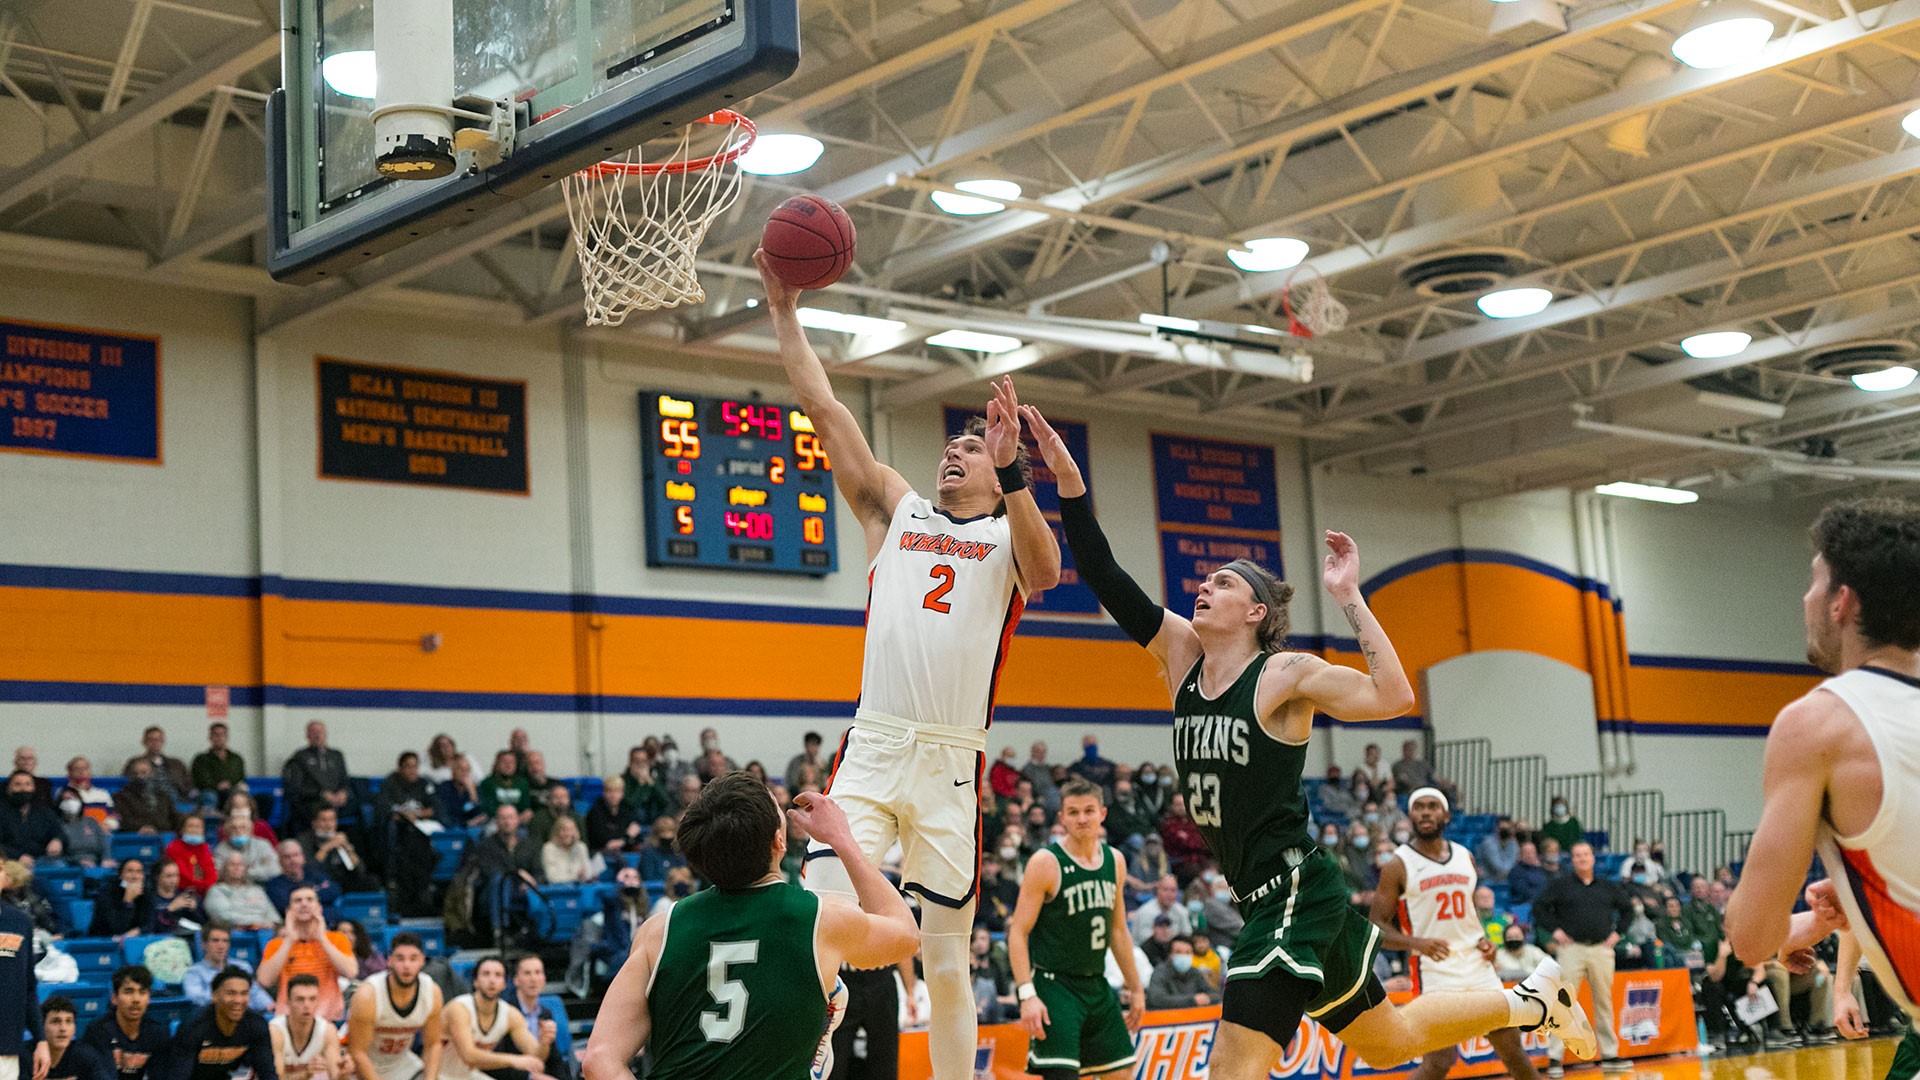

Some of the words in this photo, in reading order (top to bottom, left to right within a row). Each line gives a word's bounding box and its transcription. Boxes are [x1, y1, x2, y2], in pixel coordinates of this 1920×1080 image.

[6, 335, 90, 363] DIVISION
[0, 362, 91, 390] AMPIONS
[721, 401, 782, 441] 5:43
[661, 419, 701, 459] 55
[795, 434, 831, 470] 54
[769, 456, 786, 485] 2
[677, 506, 694, 535] 5
[803, 516, 825, 545] 10
[899, 531, 998, 562] WHEATON
[922, 564, 956, 614] 2
[1174, 715, 1250, 767] TITANS
[1187, 771, 1222, 828] 23
[1436, 891, 1466, 921] 20
[1091, 915, 1106, 950] 2
[699, 939, 760, 1043] 5
